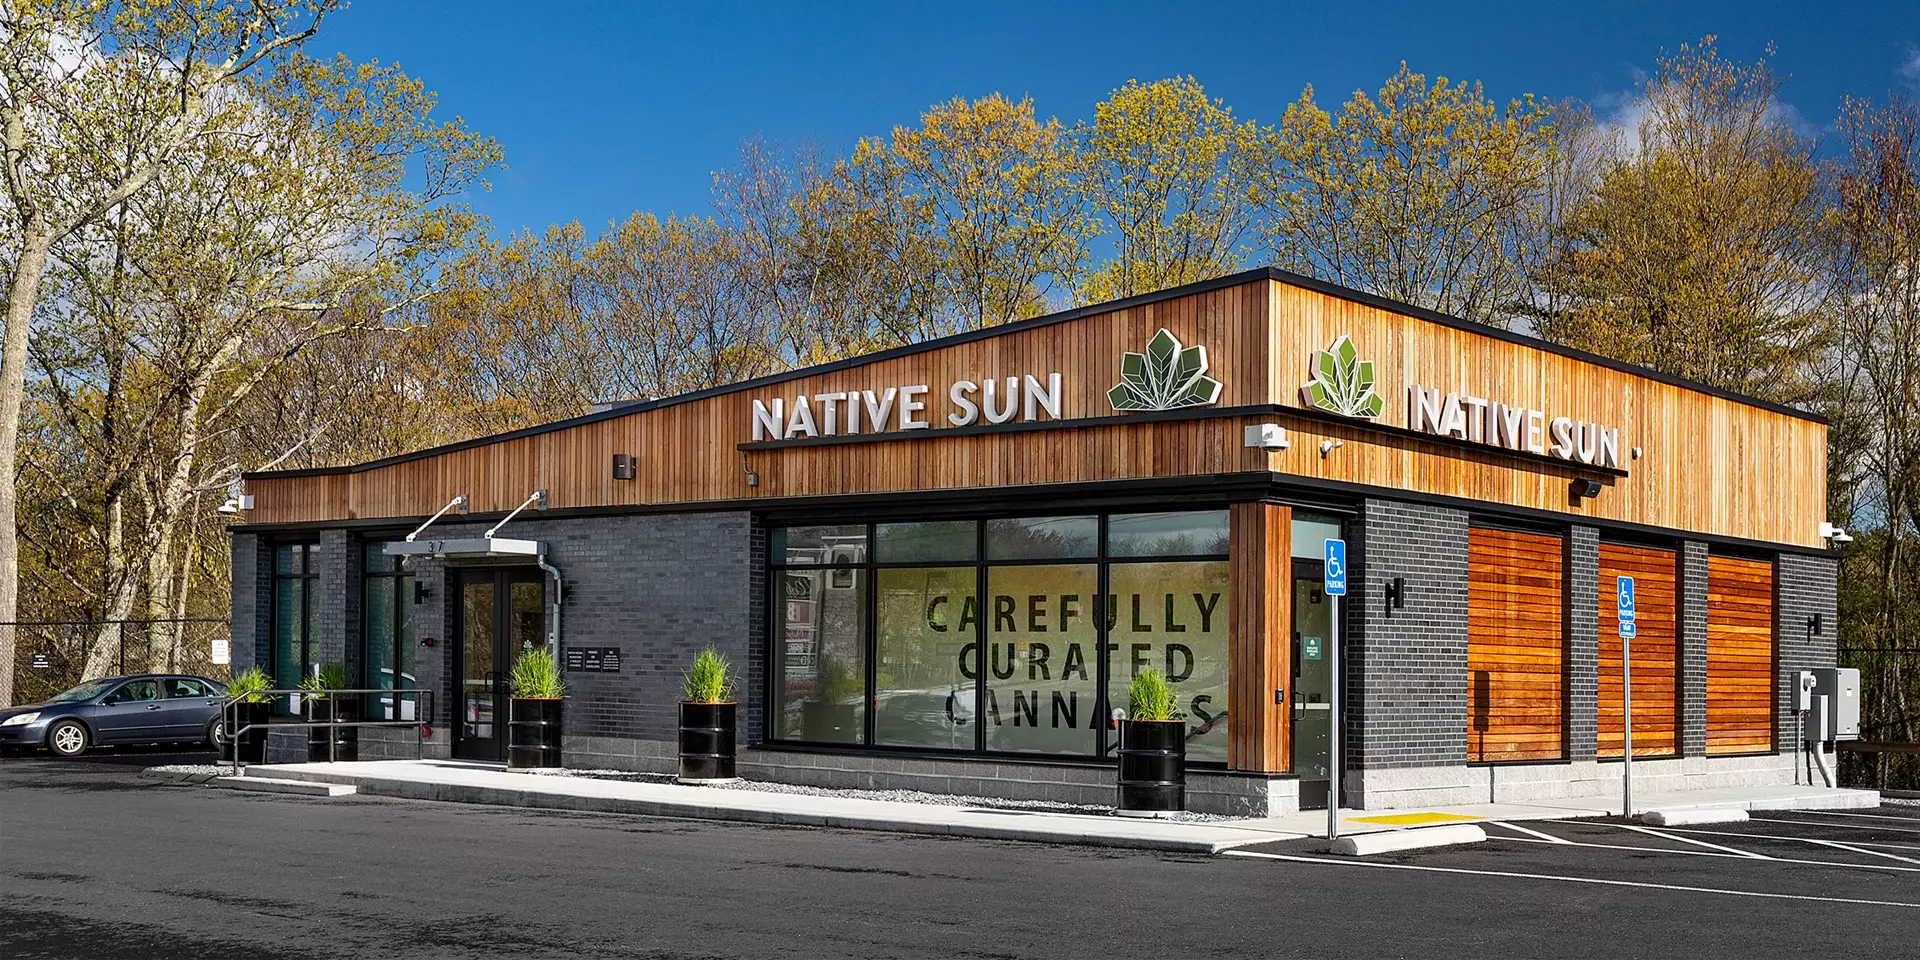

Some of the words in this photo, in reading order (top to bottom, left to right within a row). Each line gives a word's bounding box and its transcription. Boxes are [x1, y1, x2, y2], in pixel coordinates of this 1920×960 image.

[752, 384, 929, 441] NATIVE
[948, 372, 1062, 427] SUN
[1409, 383, 1544, 455] NATIVE
[1551, 416, 1619, 468] SUN
[428, 541, 444, 552] 37
[1327, 580, 1344, 588] PARKING
[926, 593, 1221, 633] CAREFULLY
[958, 642, 1194, 682] CURATED
